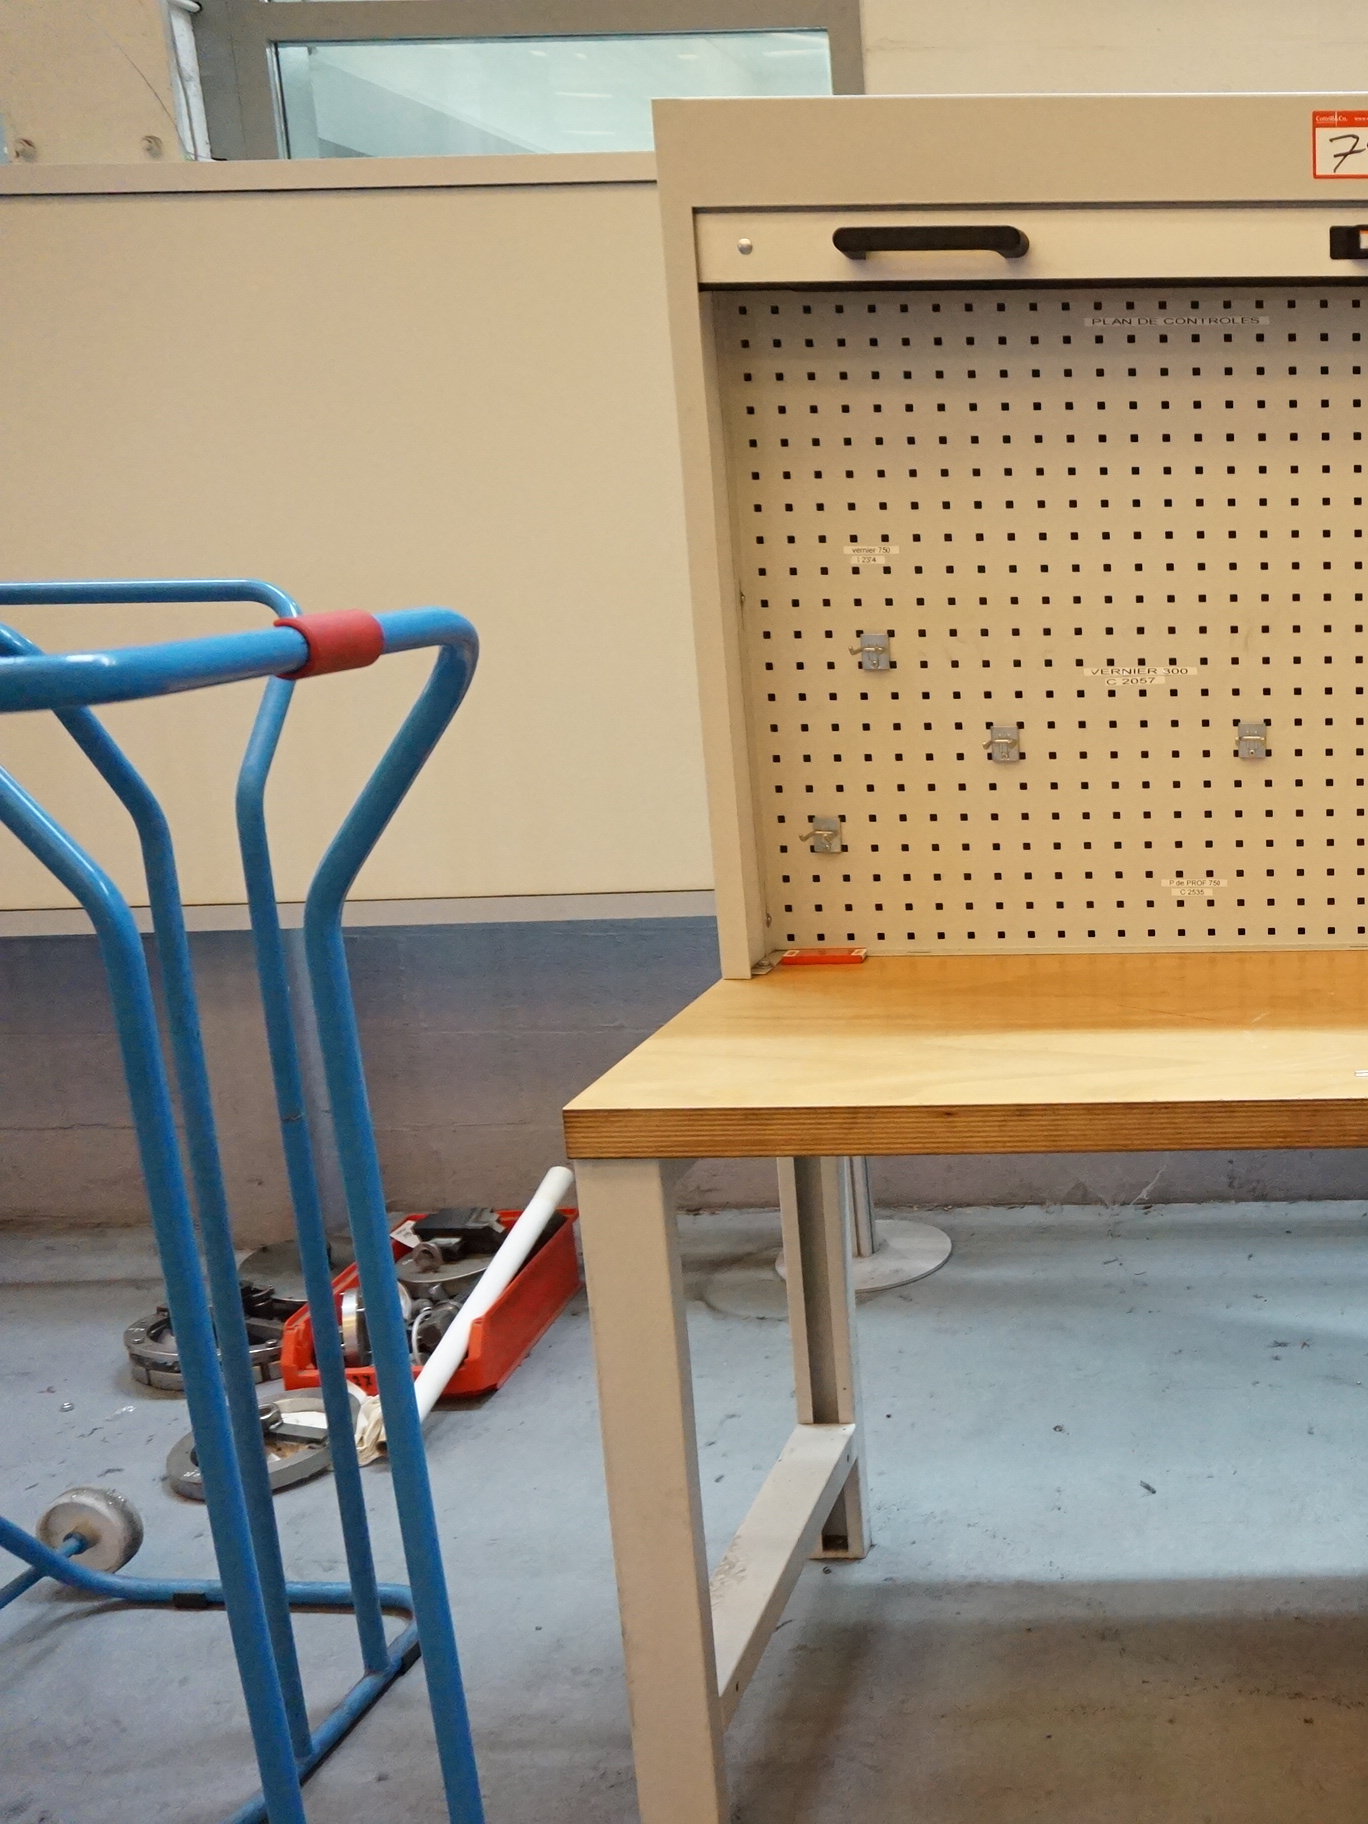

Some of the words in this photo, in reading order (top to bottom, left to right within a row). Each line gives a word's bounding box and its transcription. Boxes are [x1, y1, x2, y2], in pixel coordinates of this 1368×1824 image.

[1091, 317, 1133, 326] PLAN
[1137, 317, 1158, 326] DE
[1163, 316, 1261, 326] CONTROLES
[877, 546, 891, 554] 750
[1091, 668, 1158, 676] VERNIER
[1162, 667, 1189, 675] 300
[1106, 678, 1117, 686] C
[1121, 677, 1156, 685] 2057
